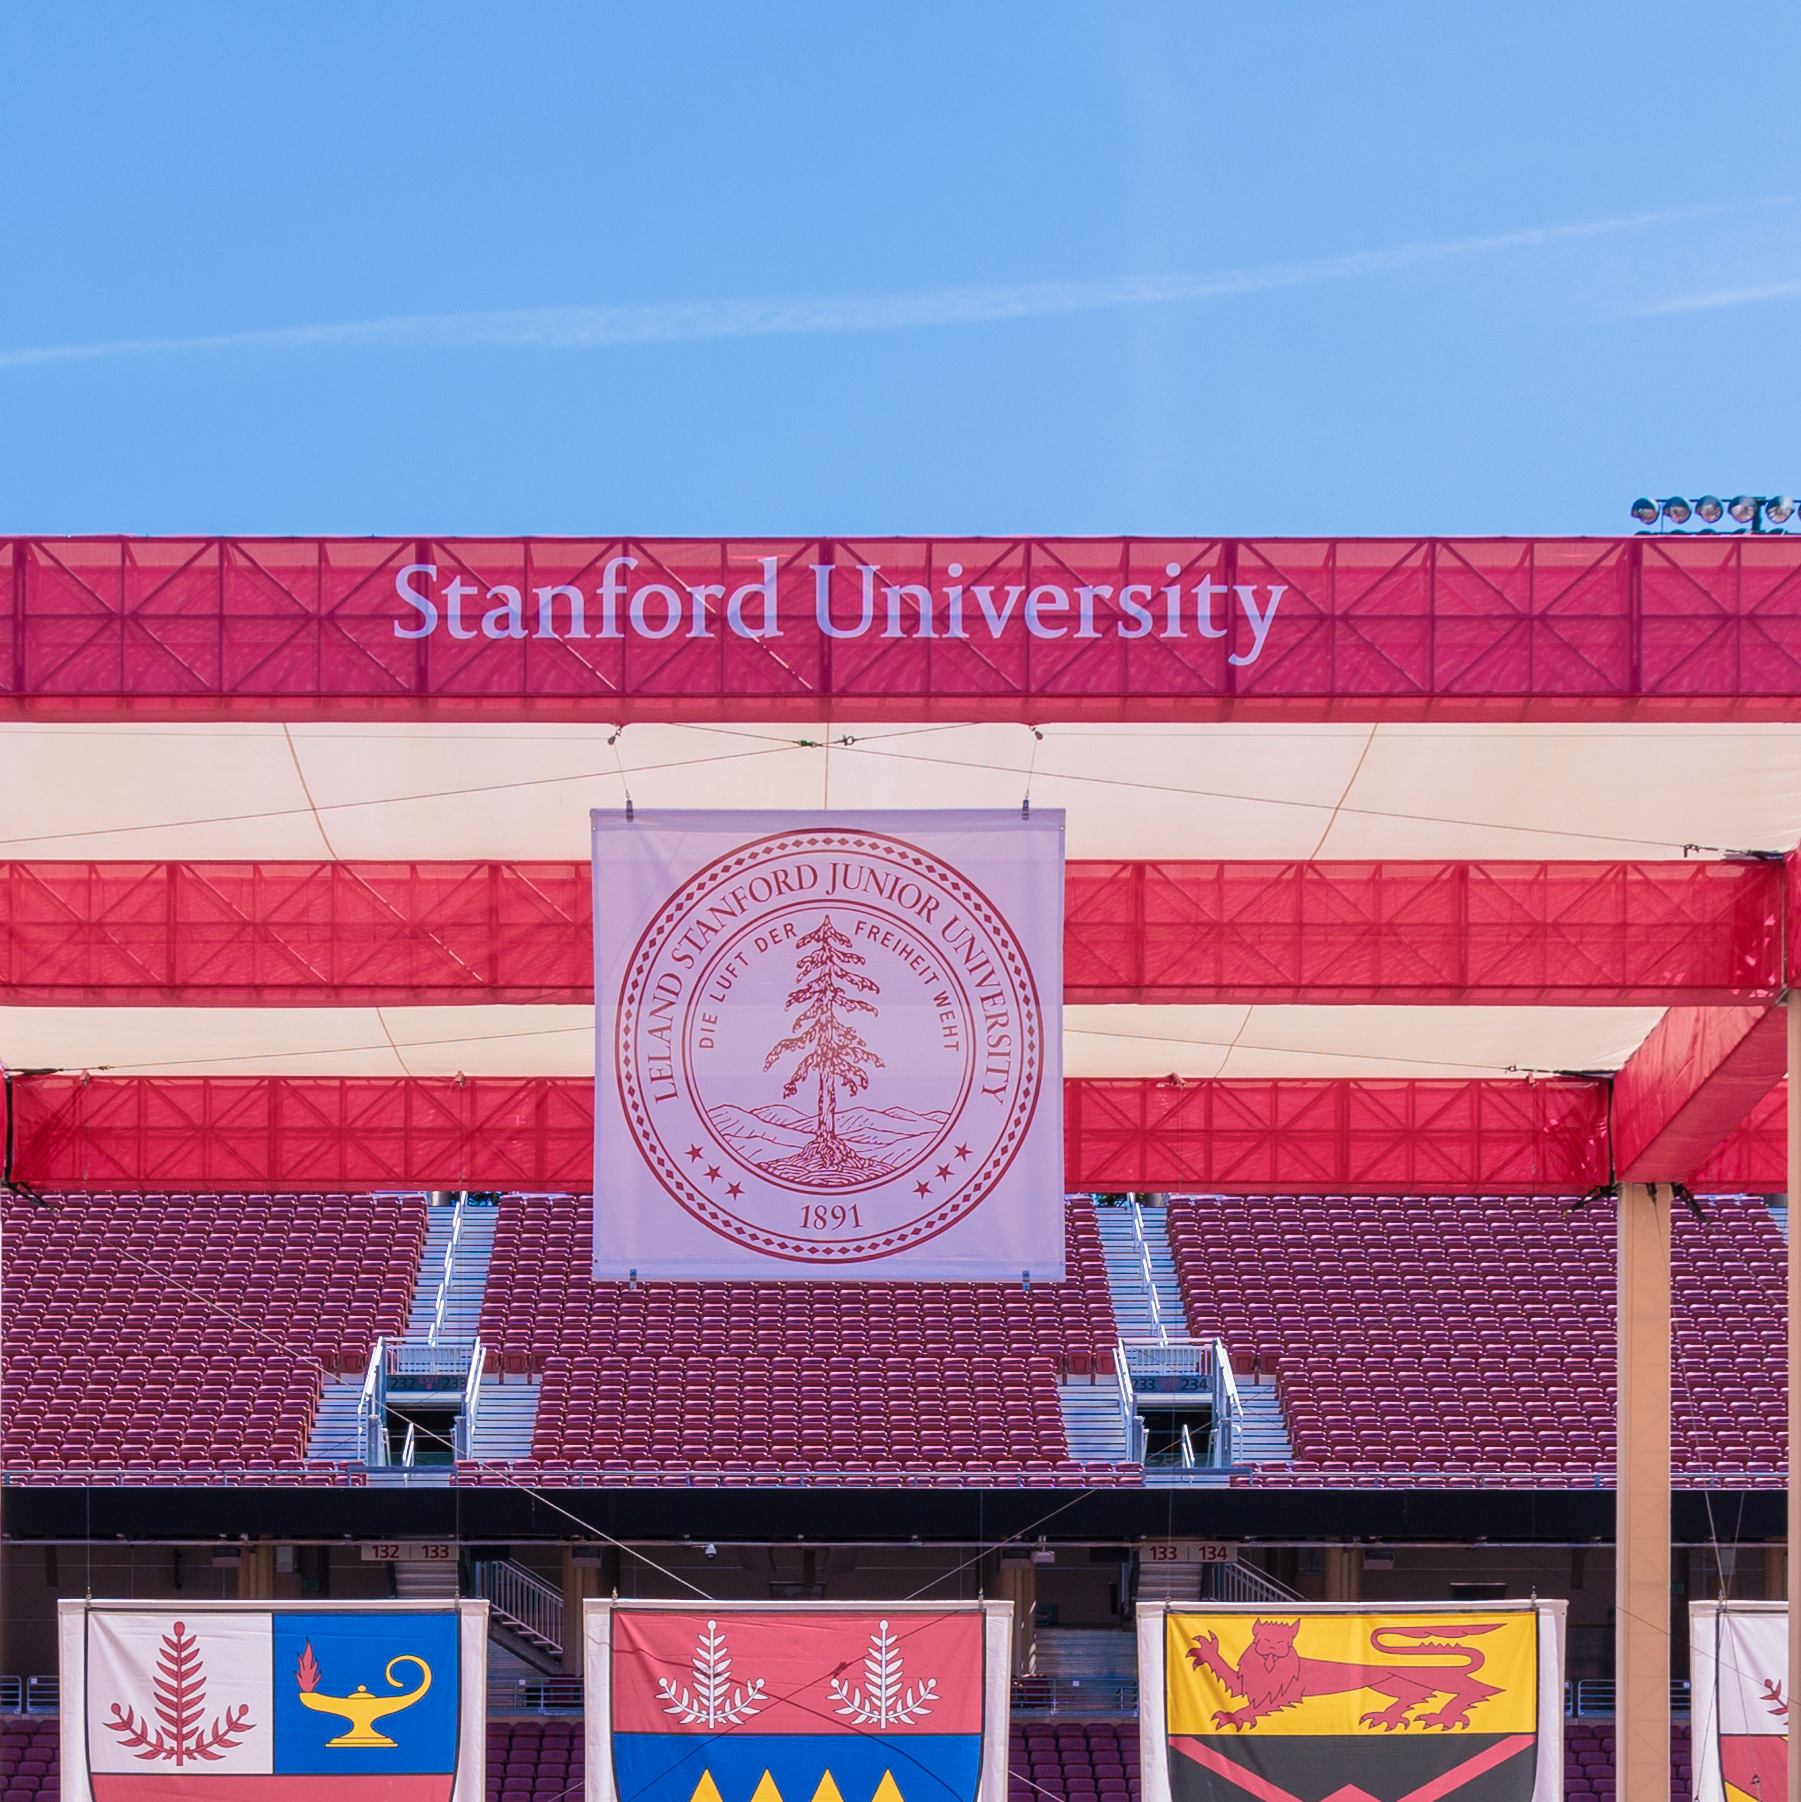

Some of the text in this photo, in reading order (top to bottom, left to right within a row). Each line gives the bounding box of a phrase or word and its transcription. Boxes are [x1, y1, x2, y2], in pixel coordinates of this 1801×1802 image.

[393, 556, 1289, 667] Stanford University
[647, 862, 1013, 1105] LELAND STANFORD JUNIOR UNIVERSITY
[699, 919, 960, 1052] DIE LUFT DER FREIHEIT WEHT
[799, 1201, 865, 1233] 1891
[390, 1377, 416, 1390] 232
[442, 1377, 468, 1390] 233
[1133, 1378, 1156, 1391] 233
[1181, 1378, 1208, 1391] 234
[371, 1544, 450, 1559] 132 133
[1149, 1545, 1228, 1561] 133 134
